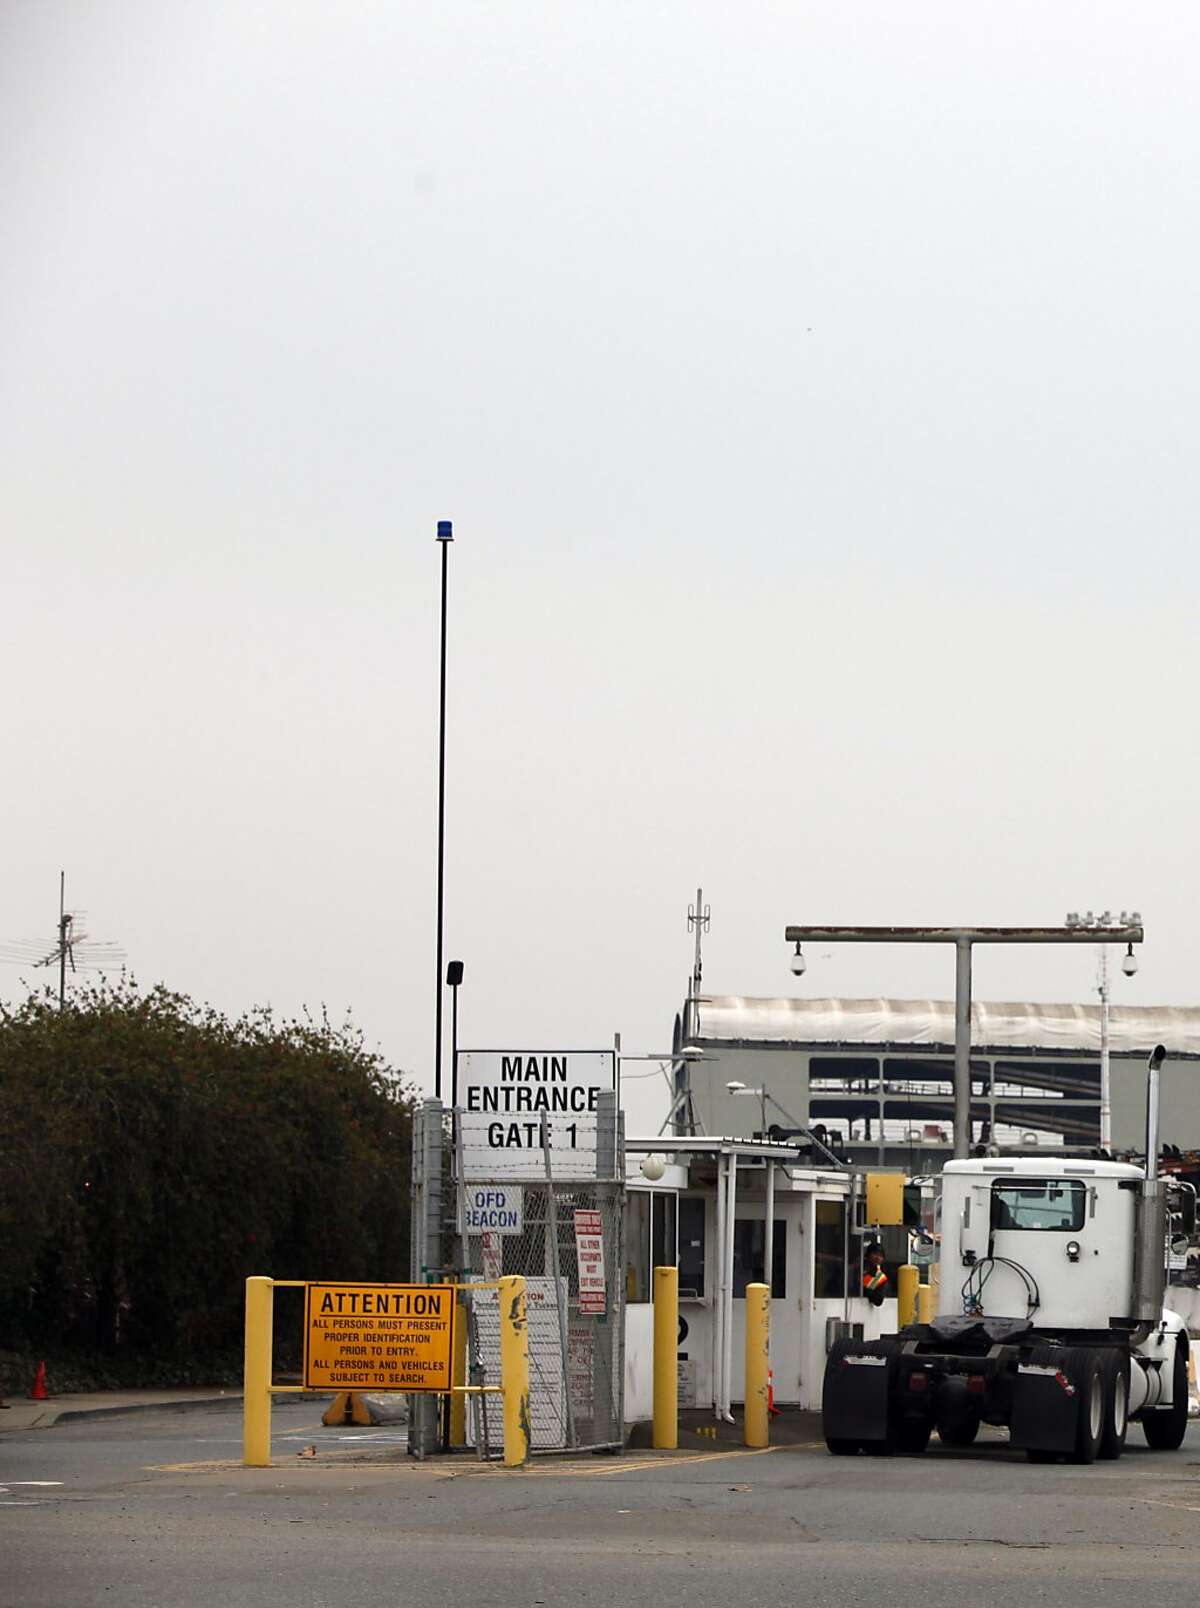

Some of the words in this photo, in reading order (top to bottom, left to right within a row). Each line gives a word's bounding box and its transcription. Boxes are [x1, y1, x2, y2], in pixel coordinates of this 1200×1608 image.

[502, 1056, 567, 1082] MAIN
[467, 1086, 601, 1112] ENTRANCE
[488, 1122, 553, 1149] GATE
[565, 1123, 577, 1149] 1
[475, 1192, 506, 1208] OFD
[321, 1292, 441, 1315] ATTENTION
[313, 1320, 329, 1329] ALL
[333, 1320, 374, 1330] PERSONS
[378, 1321, 403, 1330] MUST
[407, 1321, 447, 1331] PRESENT
[324, 1332, 360, 1342] PROPER
[363, 1333, 431, 1343] IDENTIFICATION
[340, 1346, 367, 1356] PRIOR
[371, 1346, 383, 1356] TO
[386, 1347, 418, 1357] ENTRY.
[313, 1359, 330, 1369] ALL
[334, 1360, 375, 1370] PERSONS
[379, 1361, 398, 1370] AND
[402, 1361, 445, 1371] VEHICLES
[330, 1372, 369, 1382] SUBJECT
[373, 1373, 385, 1382] TO
